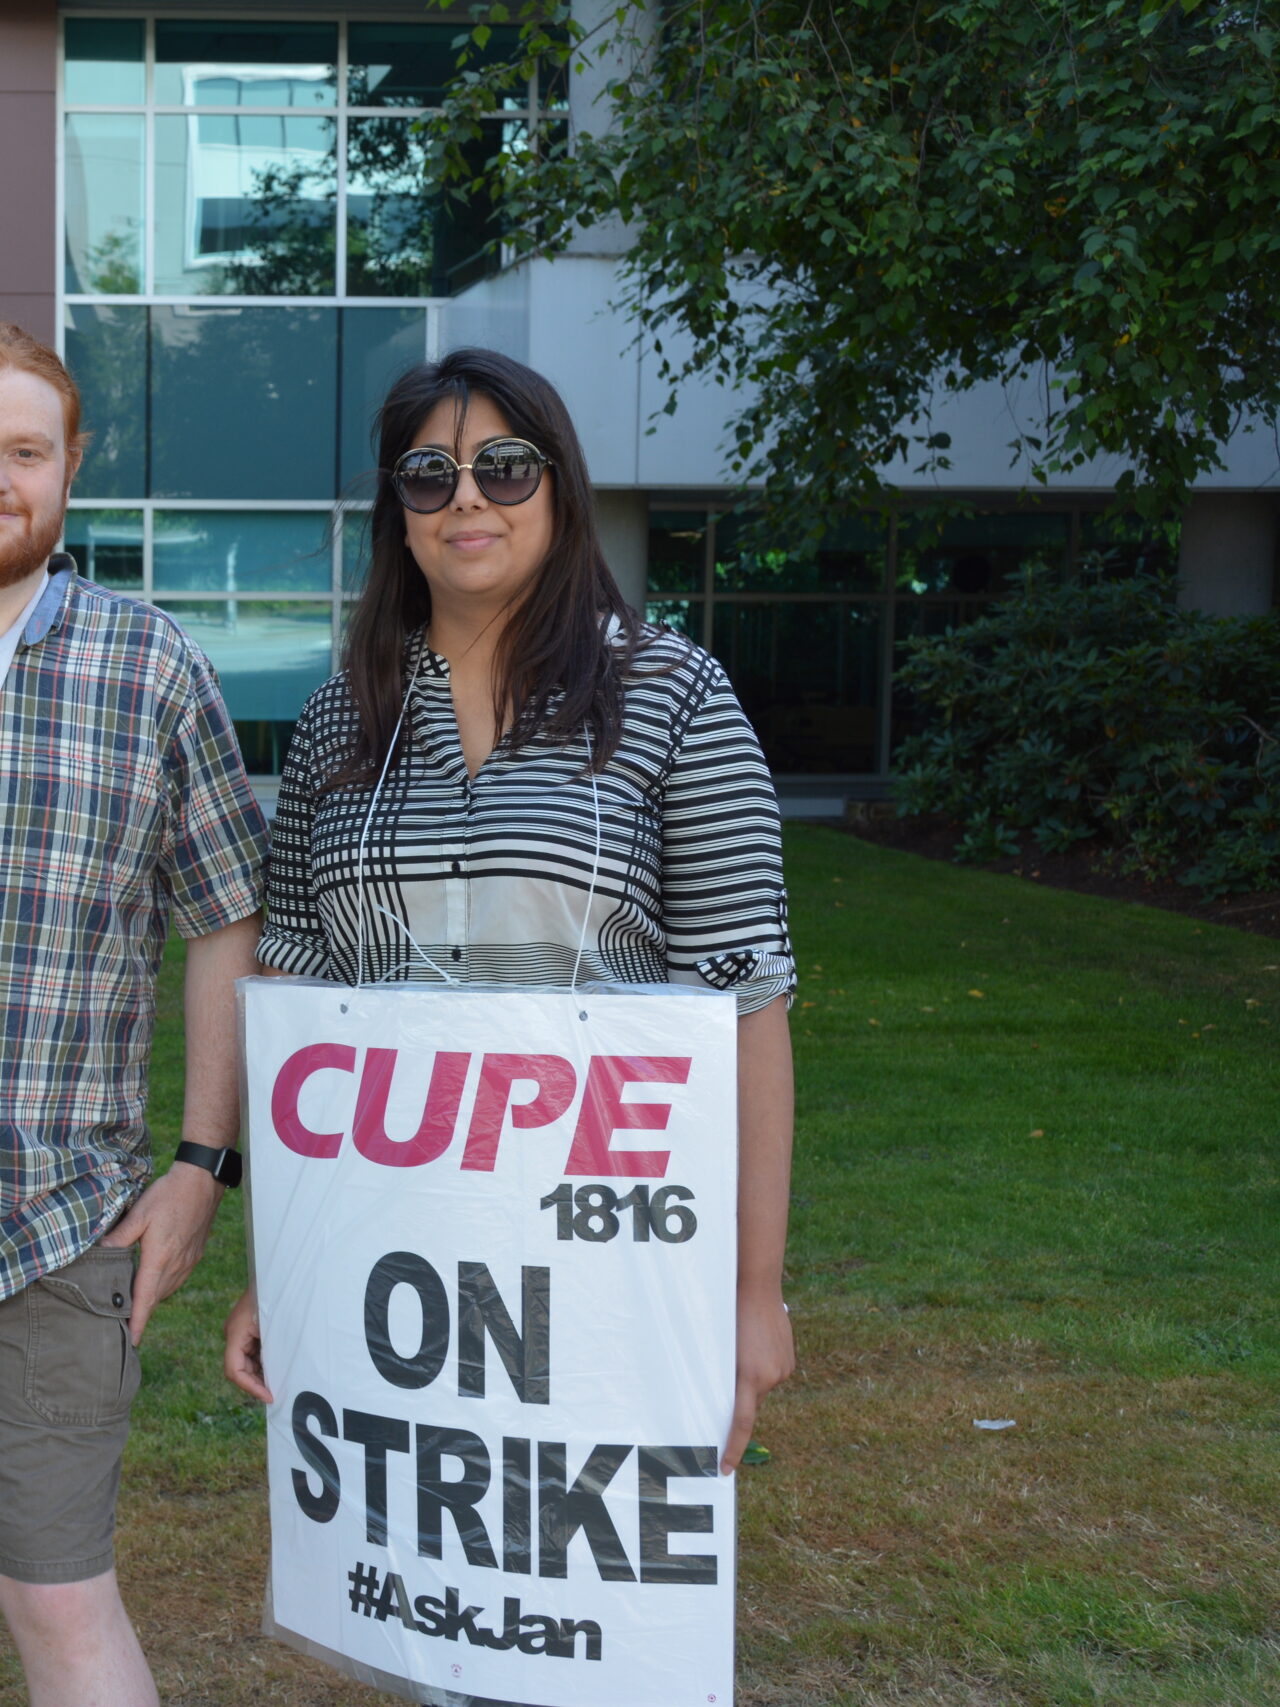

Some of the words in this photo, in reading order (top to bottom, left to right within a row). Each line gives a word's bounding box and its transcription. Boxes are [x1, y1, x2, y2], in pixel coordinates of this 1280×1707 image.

[270, 1042, 693, 1178] CUPE
[540, 1183, 698, 1244] 1816
[363, 1250, 551, 1406] ON
[290, 1390, 719, 1586] STRIKE
[347, 1560, 603, 1661] #AskJan
